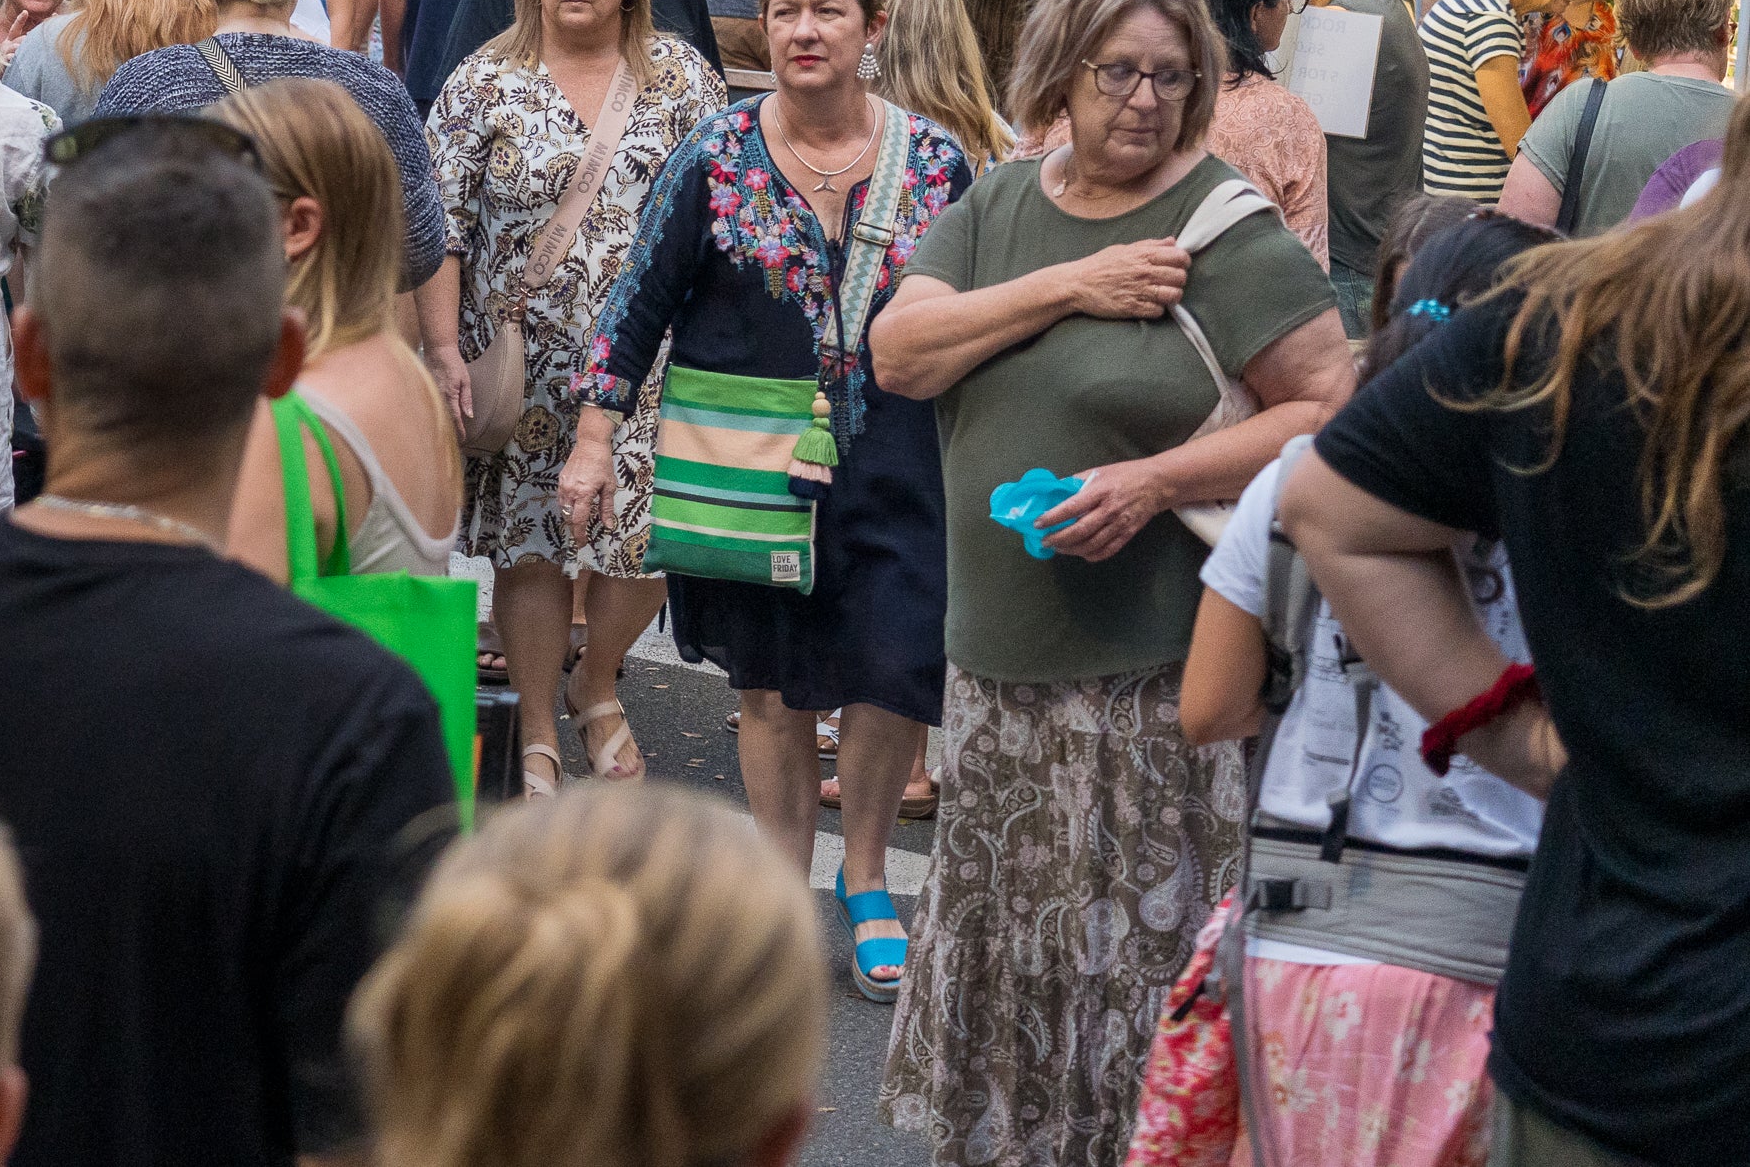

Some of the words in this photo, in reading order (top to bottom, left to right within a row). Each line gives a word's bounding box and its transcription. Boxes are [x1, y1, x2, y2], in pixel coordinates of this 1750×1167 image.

[578, 141, 609, 195] MIMCO
[533, 223, 568, 277] MIMCO
[773, 555, 792, 563] LOVE
[773, 564, 798, 572] FRIDAY
